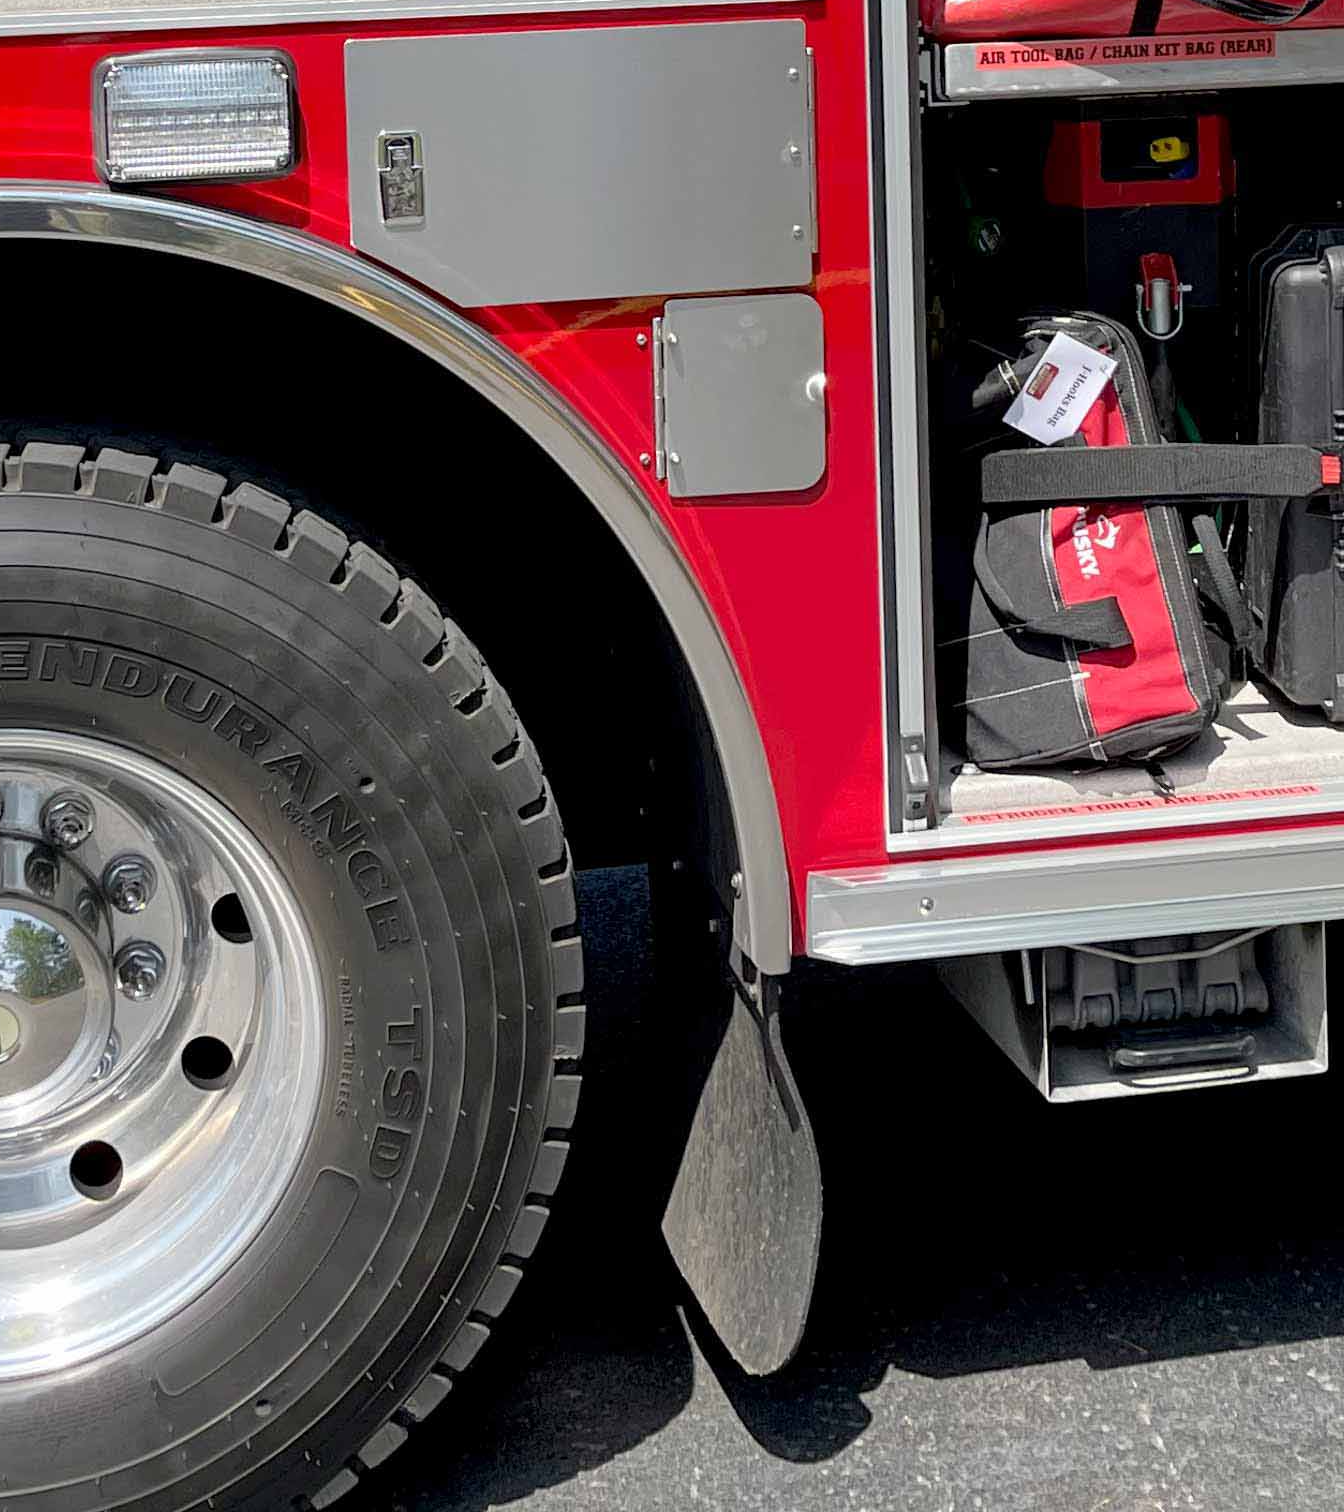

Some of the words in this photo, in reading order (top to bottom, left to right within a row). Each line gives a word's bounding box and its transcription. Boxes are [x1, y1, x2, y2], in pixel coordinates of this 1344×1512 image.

[980, 50, 1006, 65] AIR
[1011, 48, 1049, 64] TOOL
[1055, 45, 1084, 61] BAG
[1102, 44, 1150, 60] CHAIN
[1154, 42, 1181, 57] KIT
[1185, 40, 1215, 56] BAG
[1219, 37, 1273, 56] (REAR)
[1086, 798, 1153, 813] TORCH
[1248, 783, 1318, 800] TORCH
[367, 1004, 423, 1182] TSD
